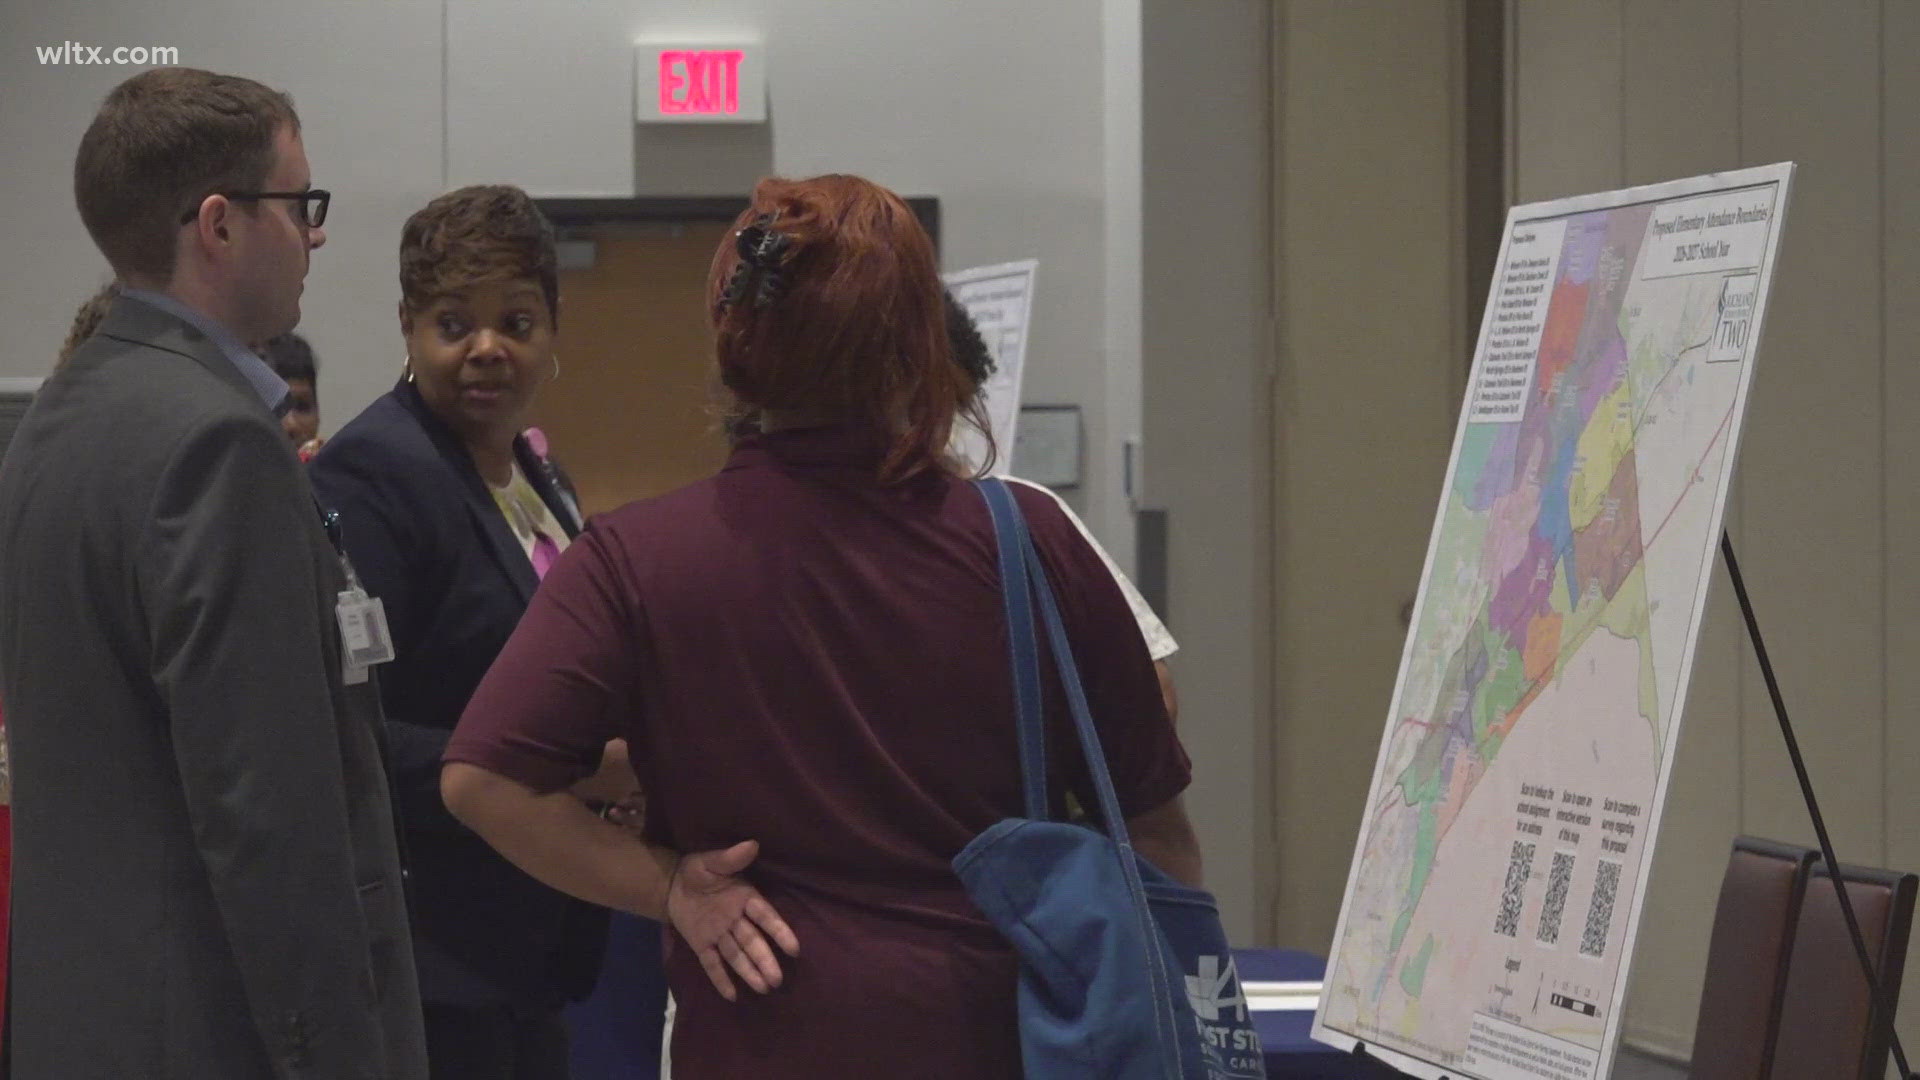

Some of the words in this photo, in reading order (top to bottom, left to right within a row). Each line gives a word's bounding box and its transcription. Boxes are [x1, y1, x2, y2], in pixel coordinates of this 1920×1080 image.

[659, 50, 745, 114] EXIT
[1698, 240, 1720, 259] School
[1720, 319, 1747, 349] TWO
[1603, 797, 1614, 811] Scan
[1618, 802, 1638, 817] complete
